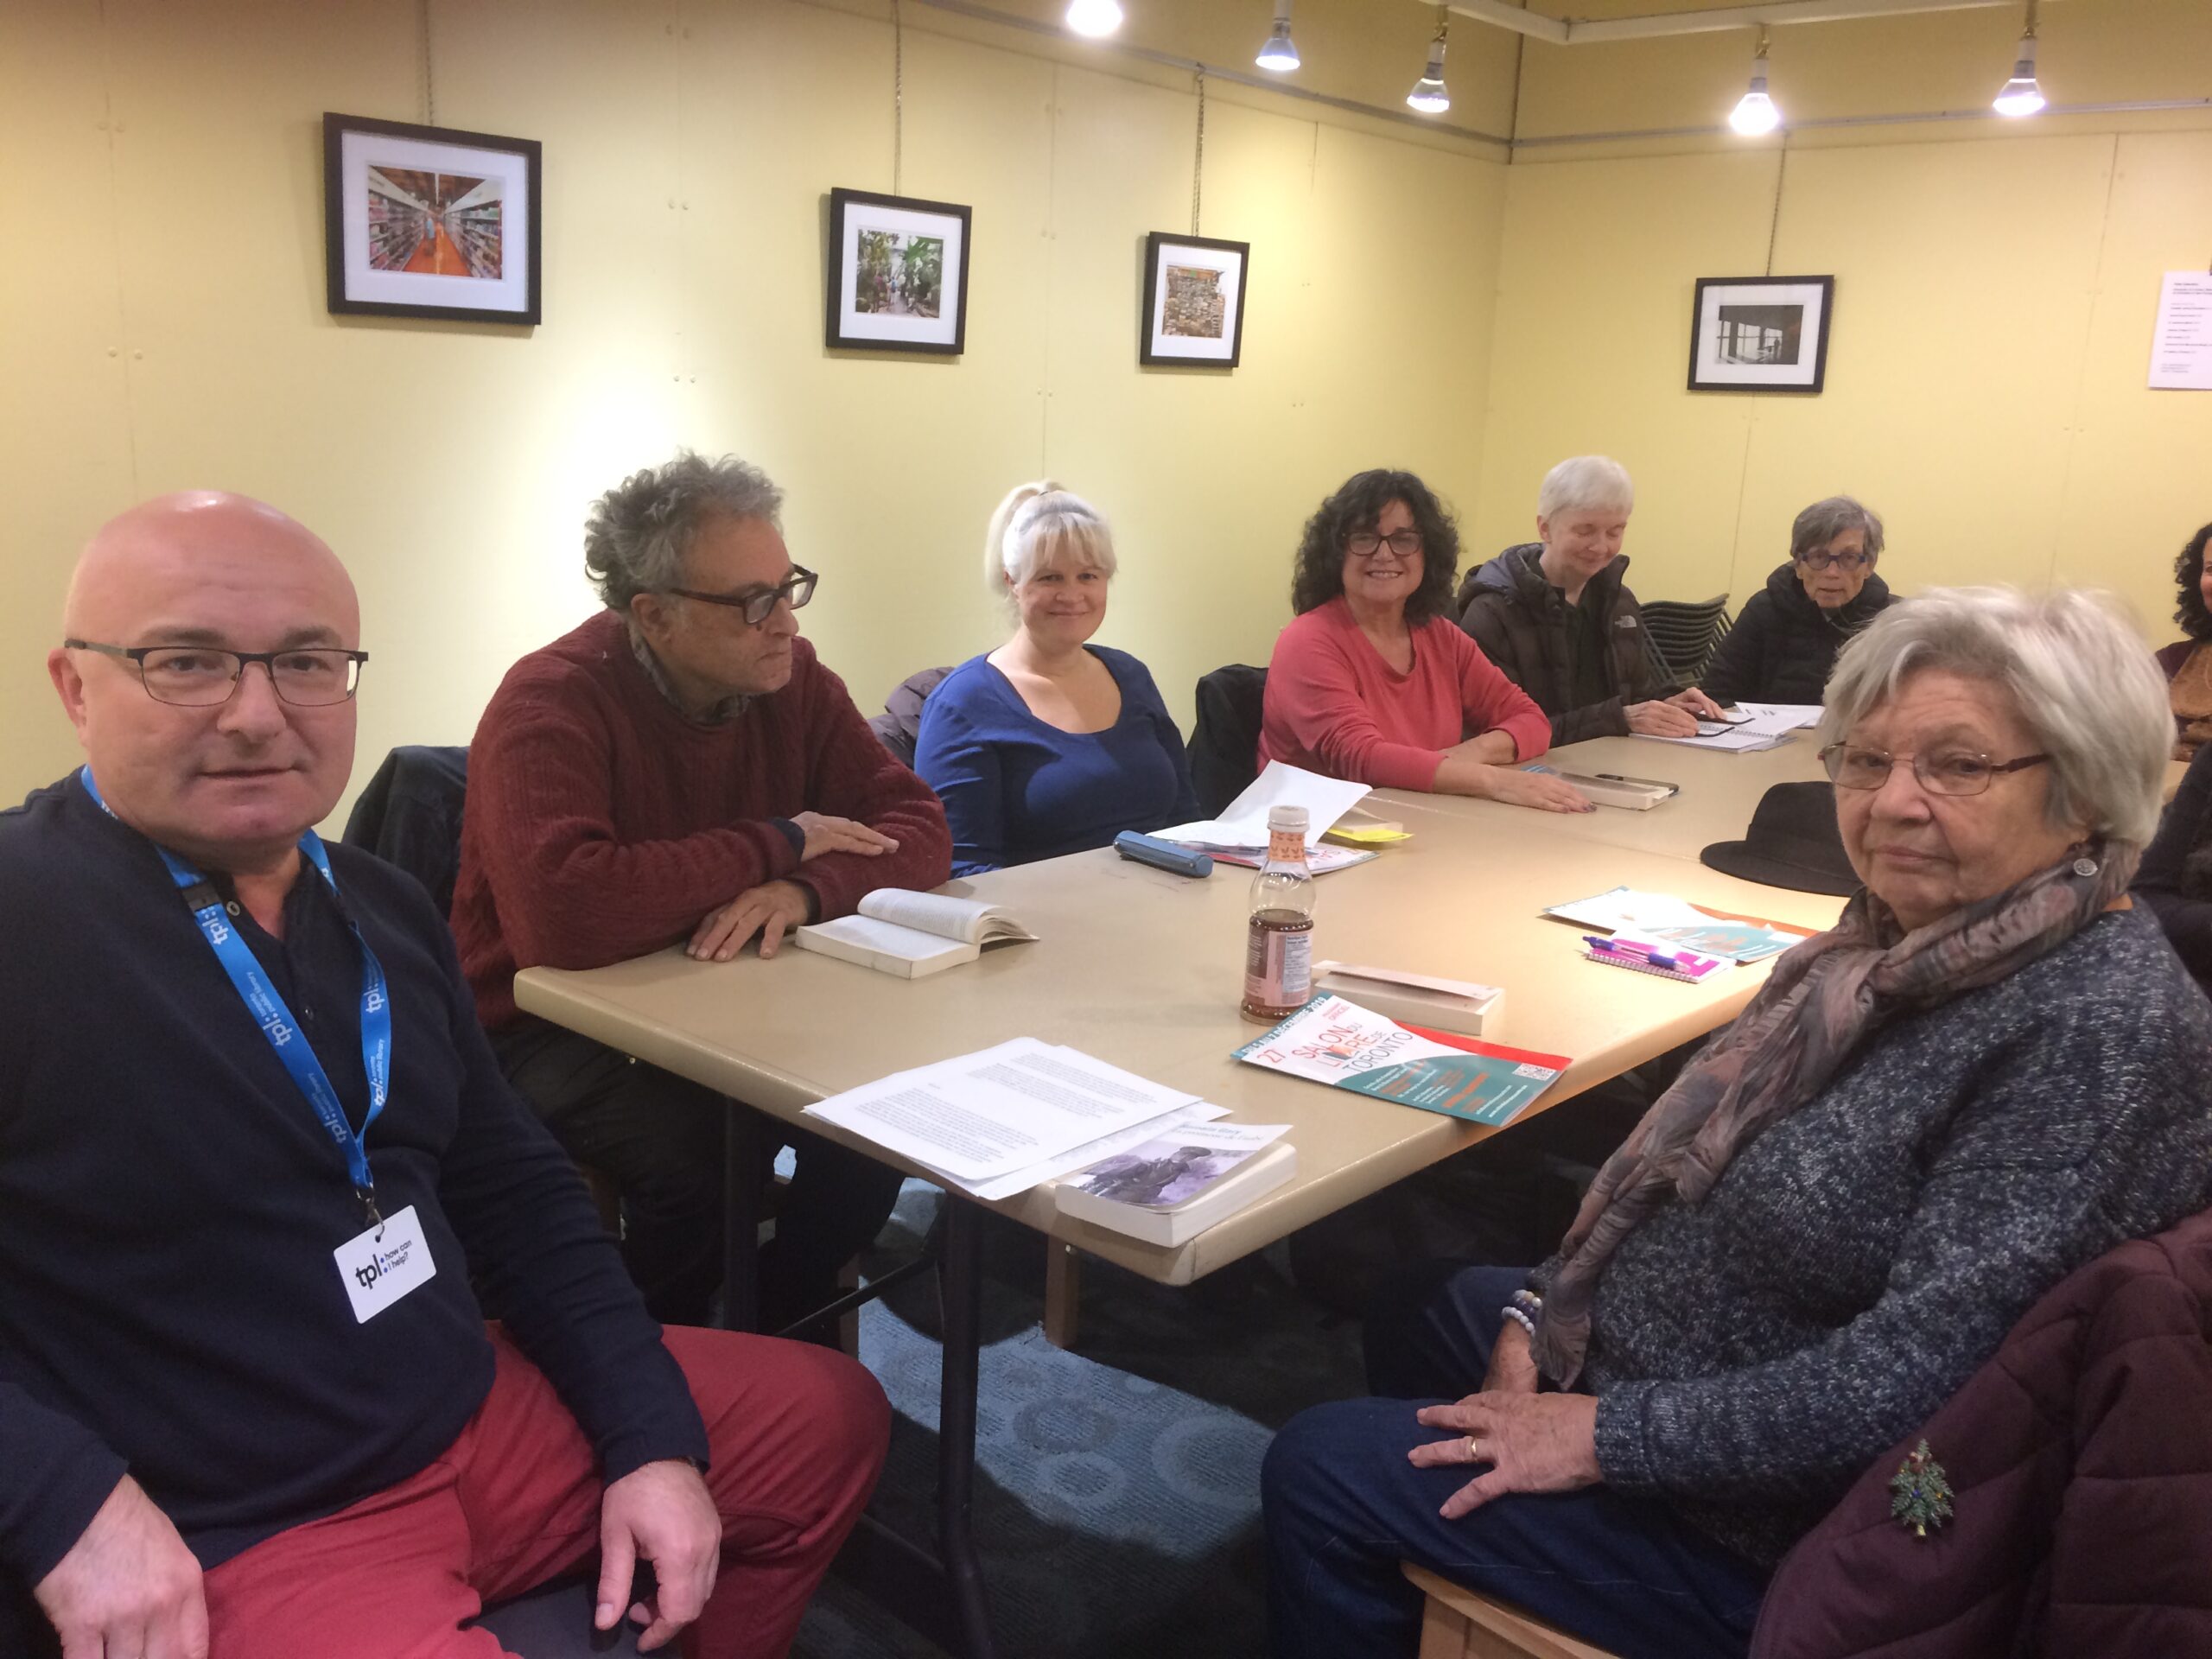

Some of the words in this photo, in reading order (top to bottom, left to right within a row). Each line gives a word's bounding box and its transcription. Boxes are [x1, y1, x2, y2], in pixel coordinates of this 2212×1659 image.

[1306, 996, 1327, 1012] 2019
[1291, 1025, 1354, 1059] SALON
[1341, 1032, 1414, 1073] TORONTO
[384, 1248, 398, 1261] how
[399, 1240, 413, 1252] can
[391, 1251, 409, 1269] help?
